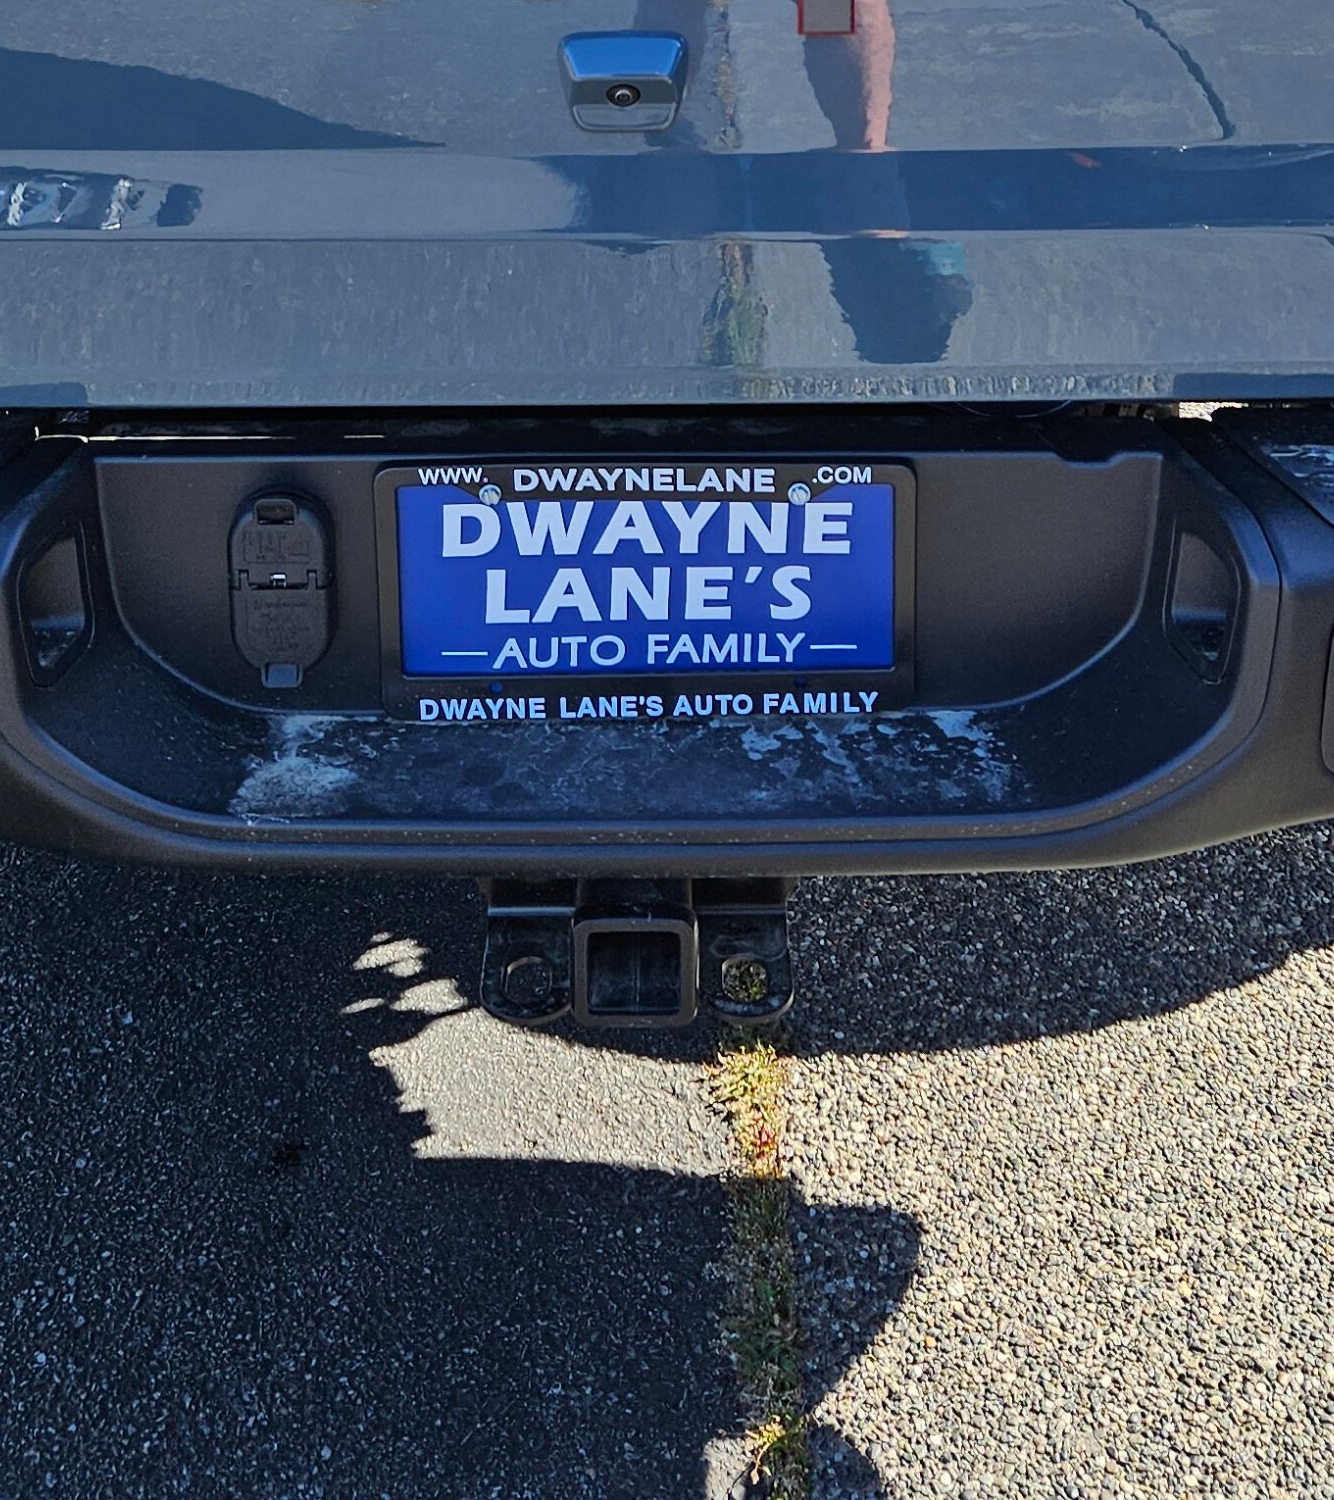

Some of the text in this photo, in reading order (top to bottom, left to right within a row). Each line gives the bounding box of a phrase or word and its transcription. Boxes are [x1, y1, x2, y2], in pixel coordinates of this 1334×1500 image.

[513, 467, 776, 493] DWAYNELANE
[811, 466, 872, 484] .COM
[442, 500, 854, 558] DWAYNE
[485, 565, 811, 625] LANE'S
[492, 632, 806, 670] AUTO FAMILY
[419, 690, 879, 721] DWAYNE LANE'S AUTO FAMILY
